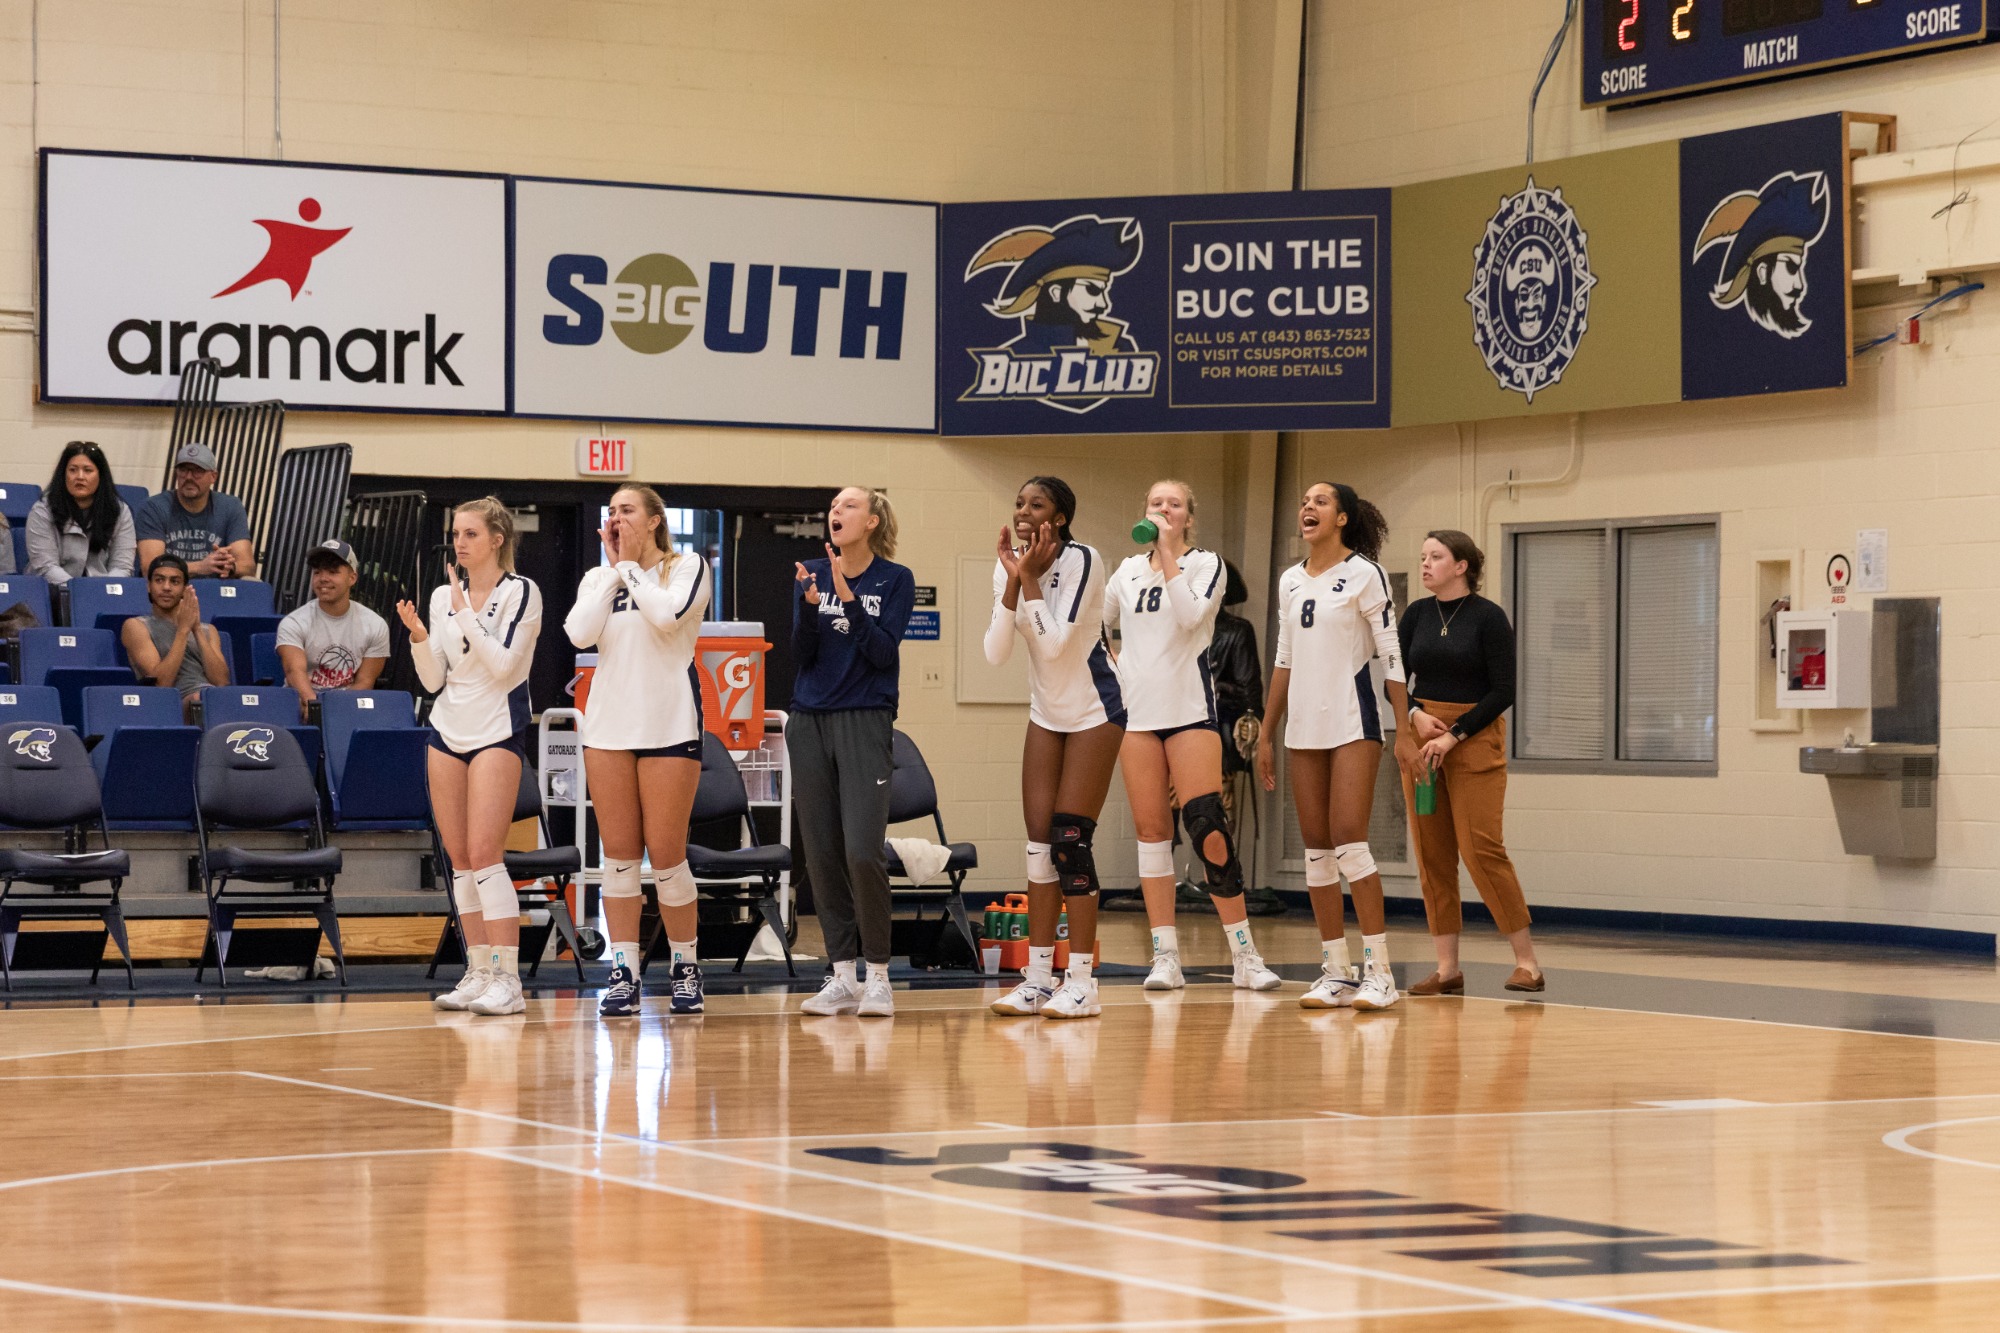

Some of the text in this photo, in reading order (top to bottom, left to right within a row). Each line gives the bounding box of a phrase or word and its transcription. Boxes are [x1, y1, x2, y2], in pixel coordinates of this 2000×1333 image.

[1906, 3, 1962, 40] SCORE
[1743, 35, 1799, 69] MATCH
[1600, 63, 1648, 96] SCORE
[1182, 238, 1362, 274] JOIN THE
[1519, 257, 1543, 276] CSU
[611, 283, 701, 327] BIG
[1176, 284, 1370, 320] BUC CLUB
[107, 313, 466, 388] aramark
[1173, 327, 1371, 346] CALL US AT (843) 863-7523
[1176, 345, 1368, 363] OR VISIT CSUSPORTS.COM
[1200, 363, 1344, 379] FOR MORE DETAILS
[589, 440, 627, 472] EXIT
[1134, 586, 1163, 614] 18
[1300, 598, 1316, 629] 8
[723, 656, 750, 689] G
[547, 744, 577, 756] GATORADE
